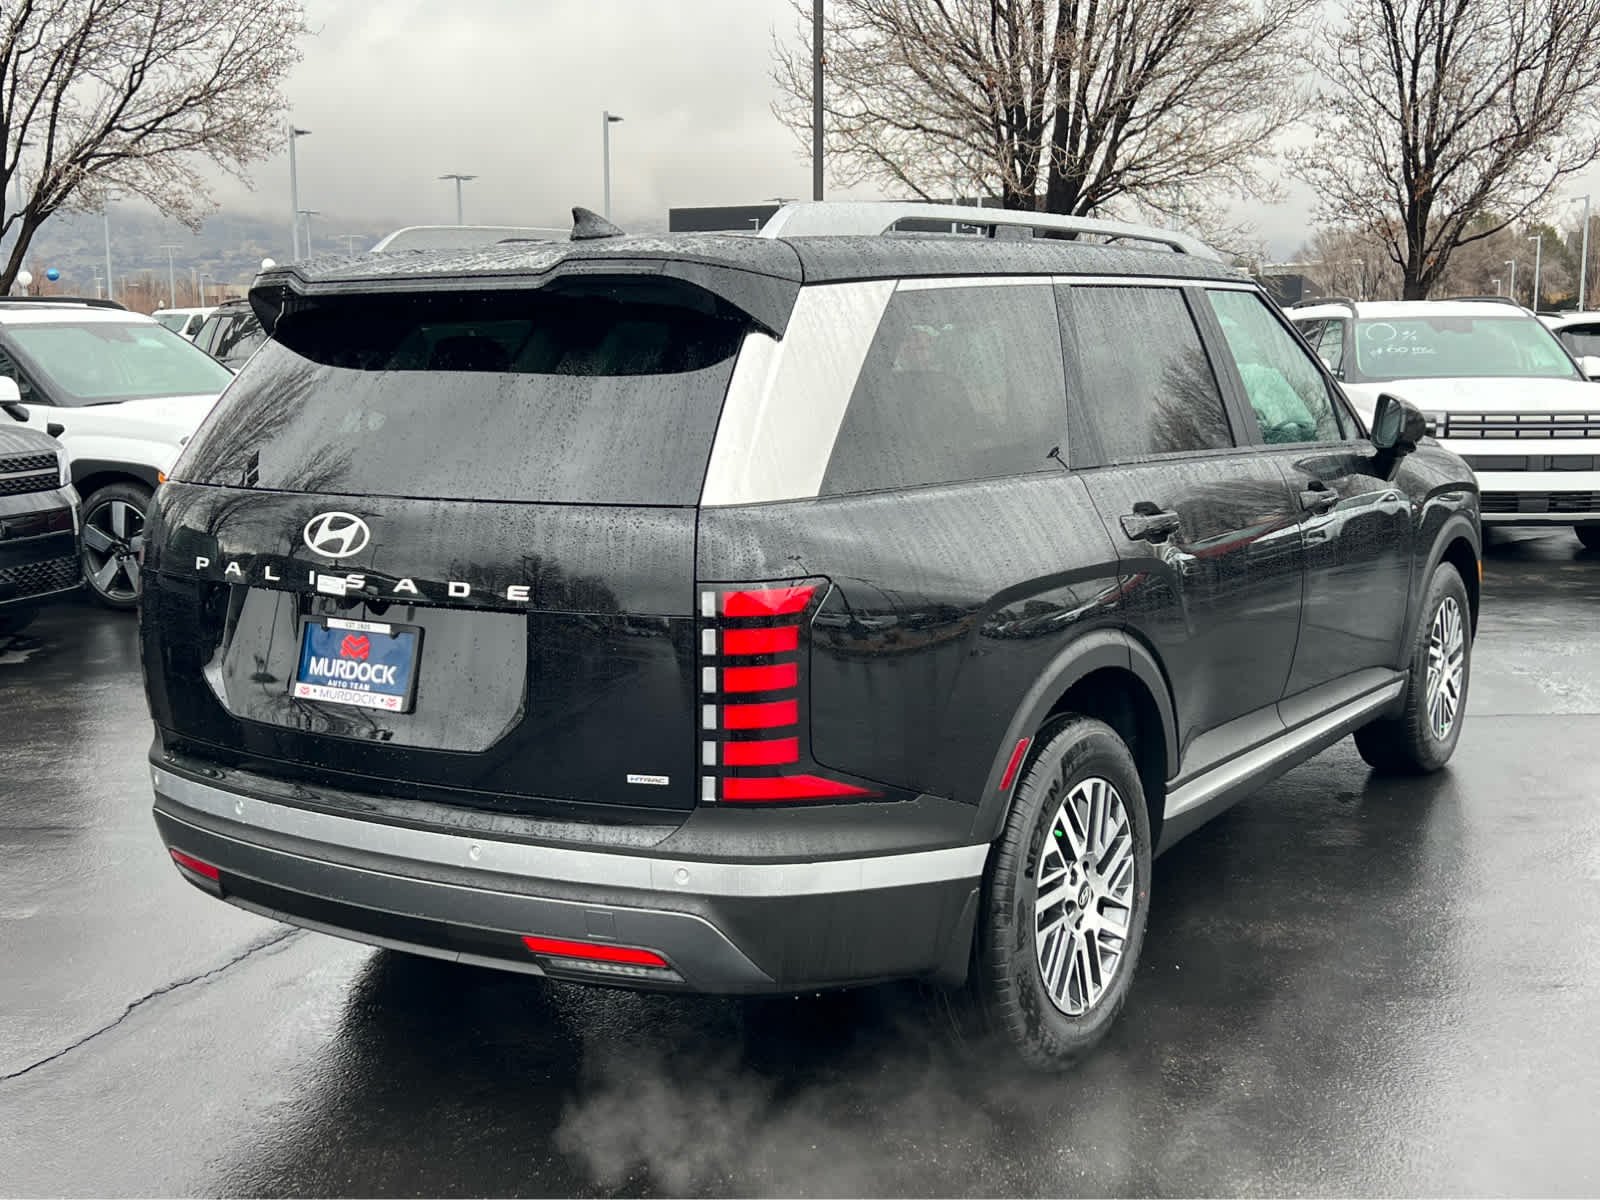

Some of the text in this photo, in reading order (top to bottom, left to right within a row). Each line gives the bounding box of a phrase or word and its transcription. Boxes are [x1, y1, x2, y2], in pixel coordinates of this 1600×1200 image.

[195, 556, 532, 602] PALISADE
[309, 656, 397, 685] MURDOCK
[319, 688, 377, 705] MURDOCK
[327, 679, 370, 691] AUTO TEAM
